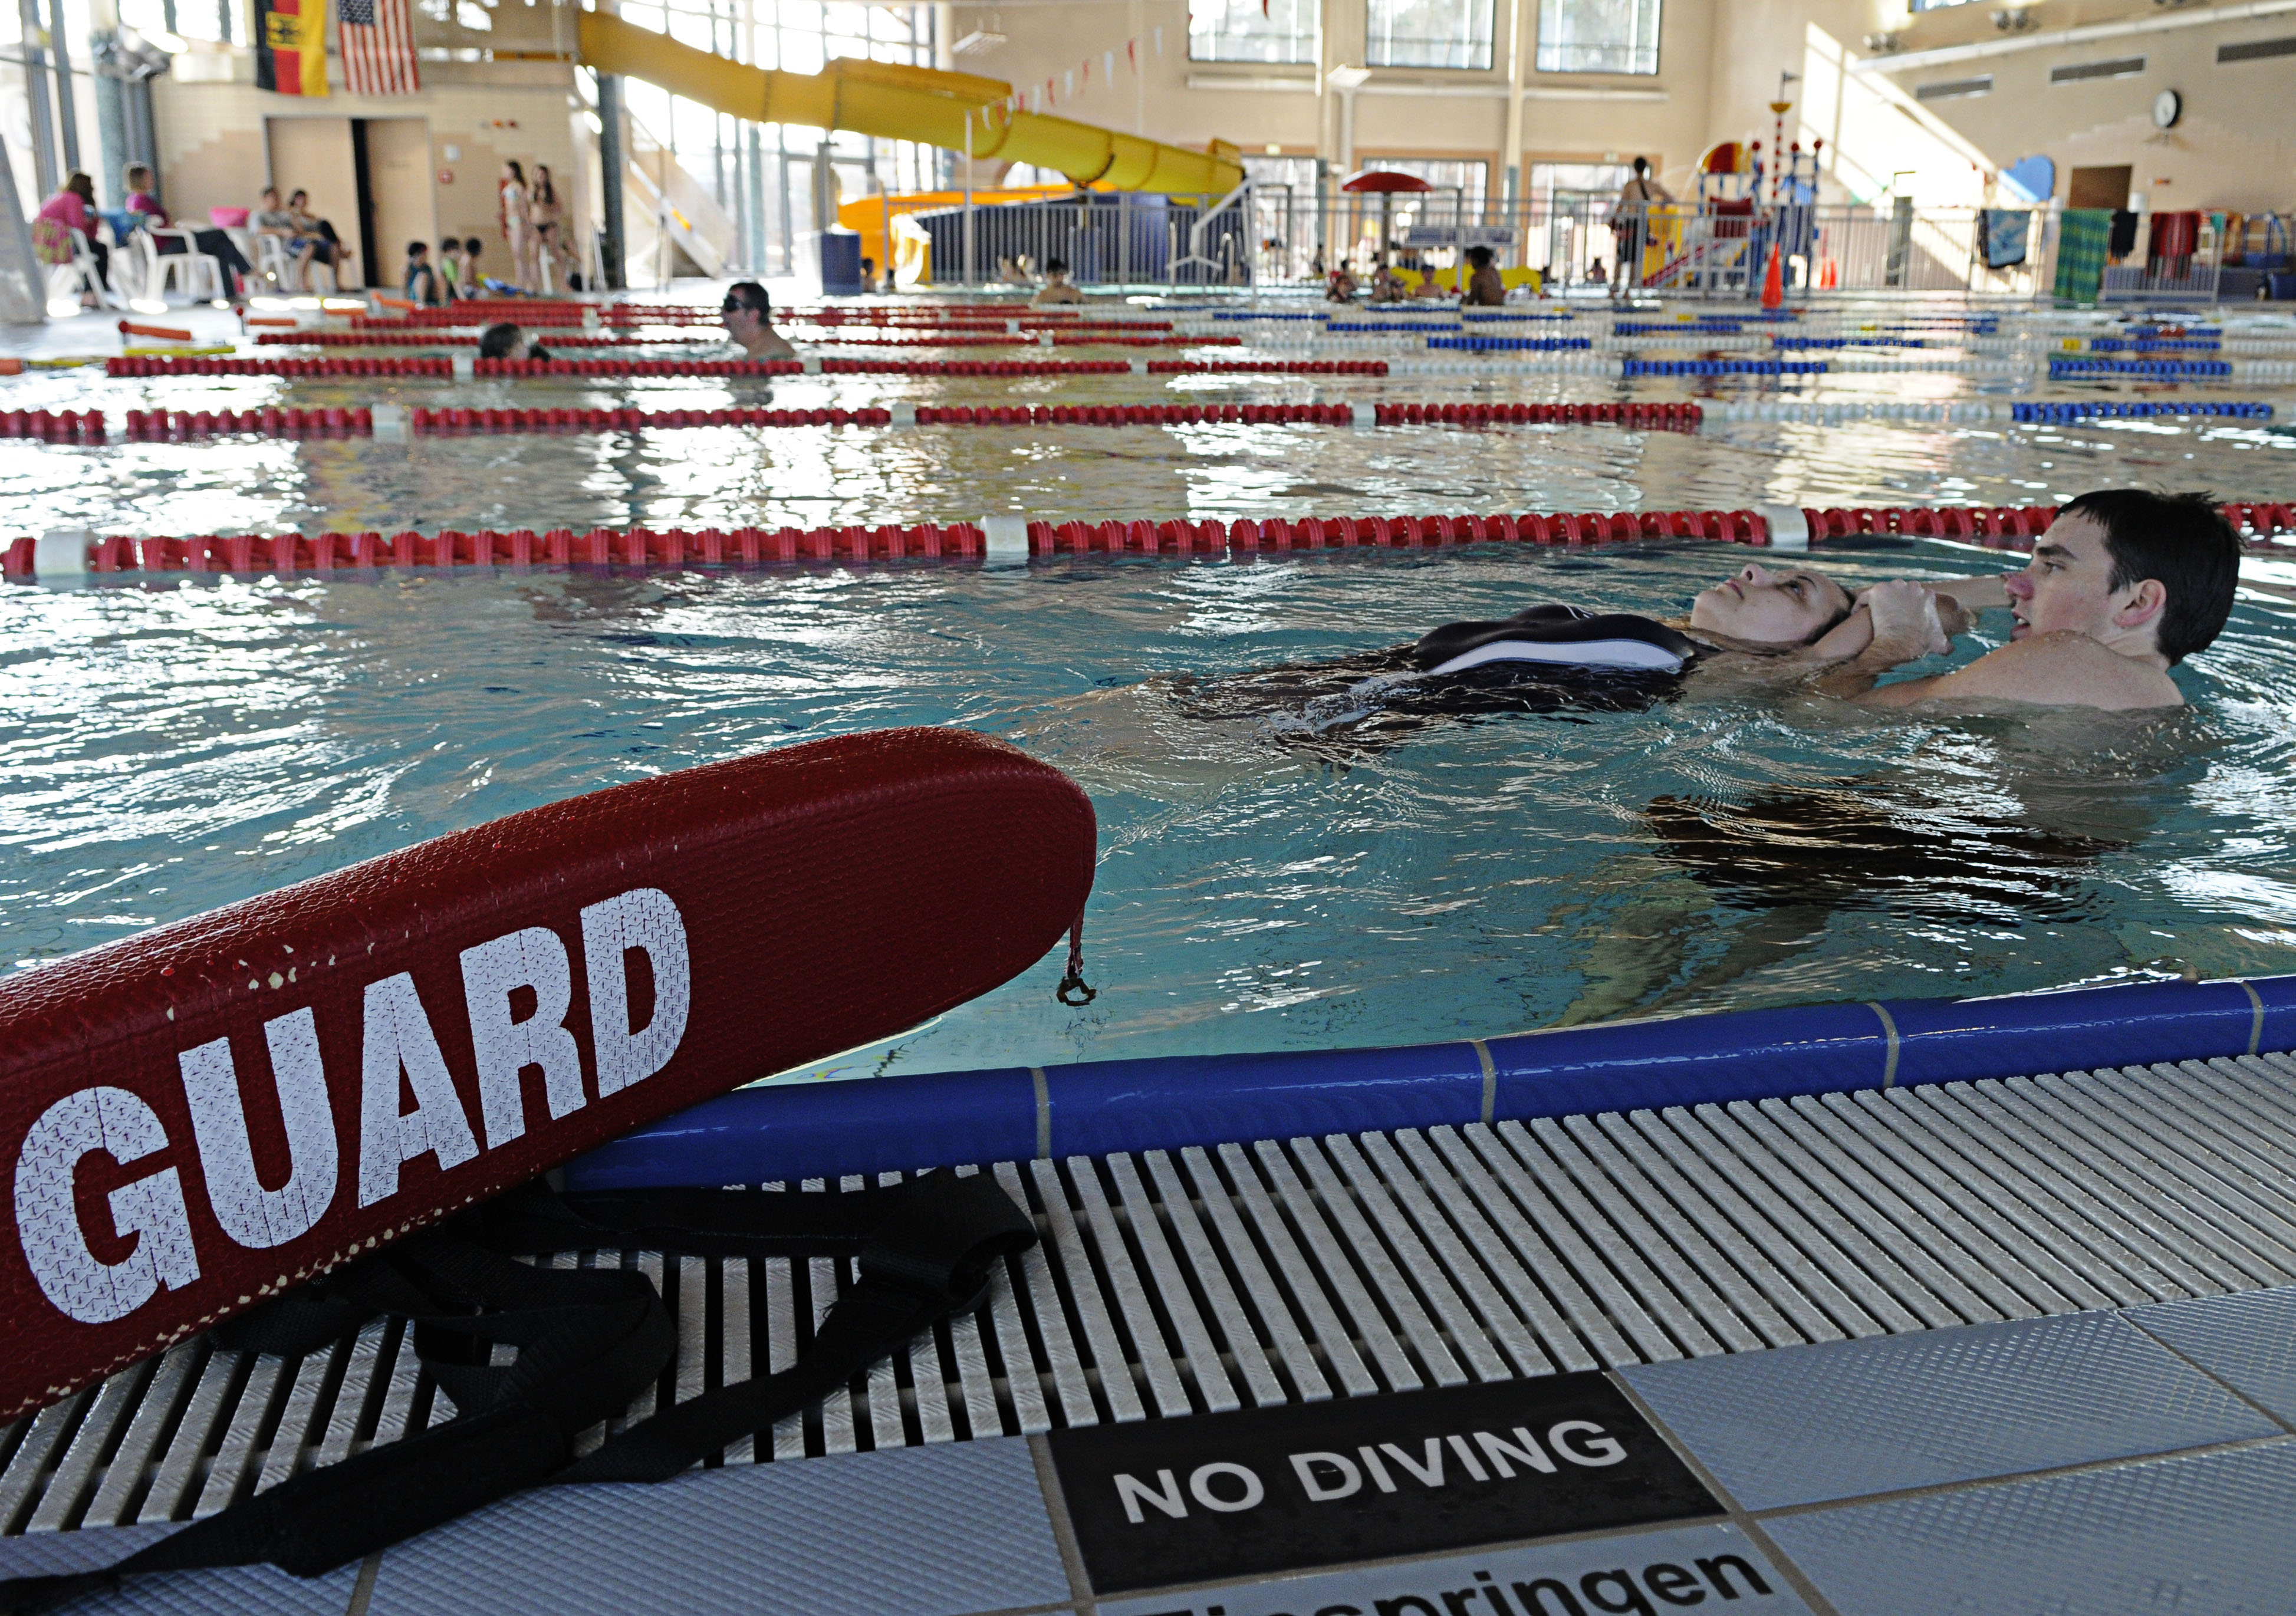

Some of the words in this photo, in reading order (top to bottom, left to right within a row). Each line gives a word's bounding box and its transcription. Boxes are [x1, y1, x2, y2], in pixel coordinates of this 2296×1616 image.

[14, 887, 691, 1324] GUARD
[1113, 1462, 1264, 1524] NO
[1288, 1420, 1628, 1502] DIVING
